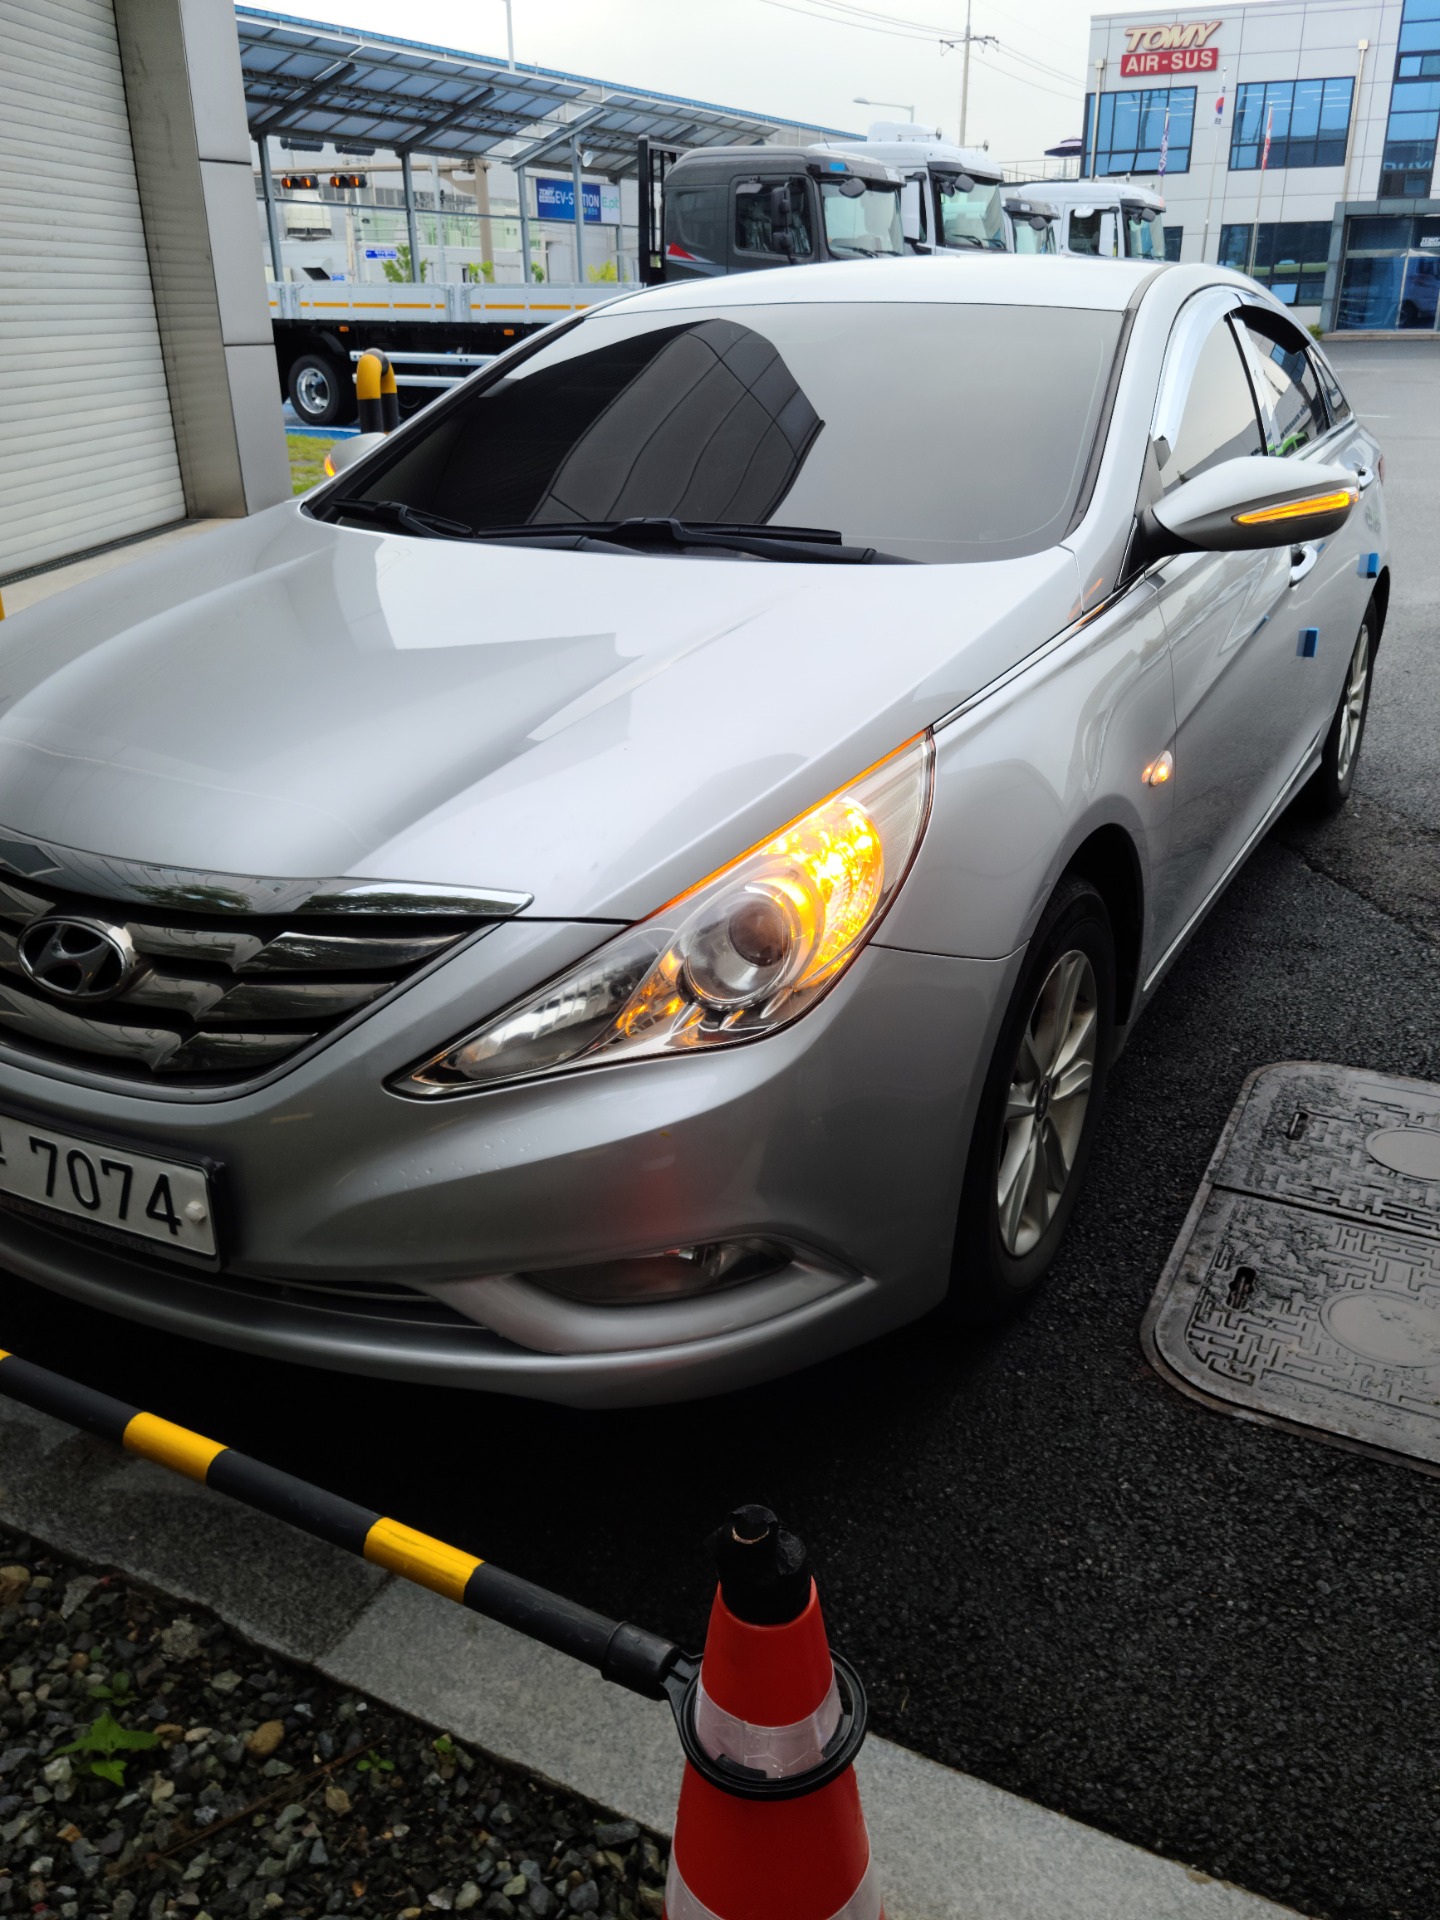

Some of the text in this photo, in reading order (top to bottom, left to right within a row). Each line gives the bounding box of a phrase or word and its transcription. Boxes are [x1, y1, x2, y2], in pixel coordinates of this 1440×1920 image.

[1125, 21, 1222, 52] TOMY
[1125, 50, 1213, 73] AIR-SUS
[555, 191, 600, 207] EV-STION
[28, 1134, 183, 1236] 7074
